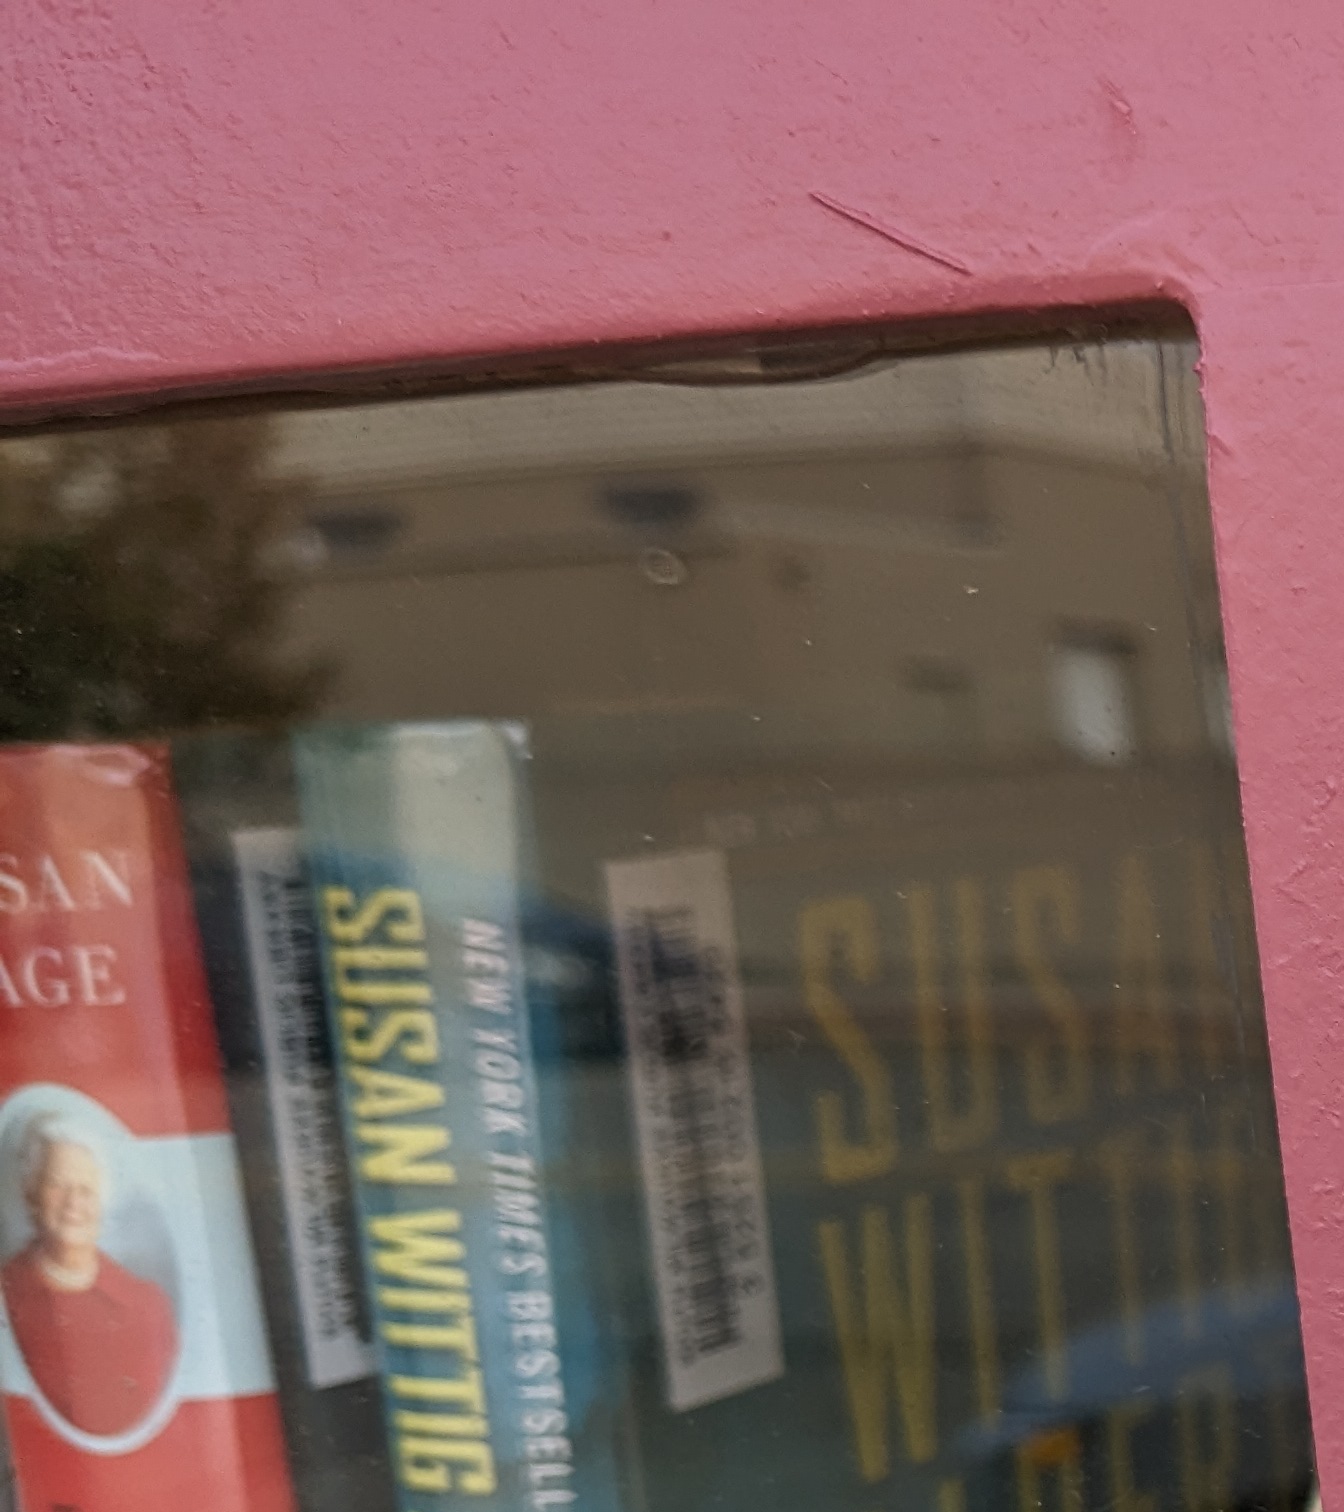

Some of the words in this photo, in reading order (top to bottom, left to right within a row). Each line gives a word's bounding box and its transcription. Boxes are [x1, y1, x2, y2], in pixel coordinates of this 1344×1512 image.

[462, 917, 511, 1026] NEW
[323, 886, 457, 1186] SUSAN
[473, 1027, 532, 1138] YORK
[489, 1150, 546, 1278] TIMES
[360, 1208, 498, 1496] WITTIG
